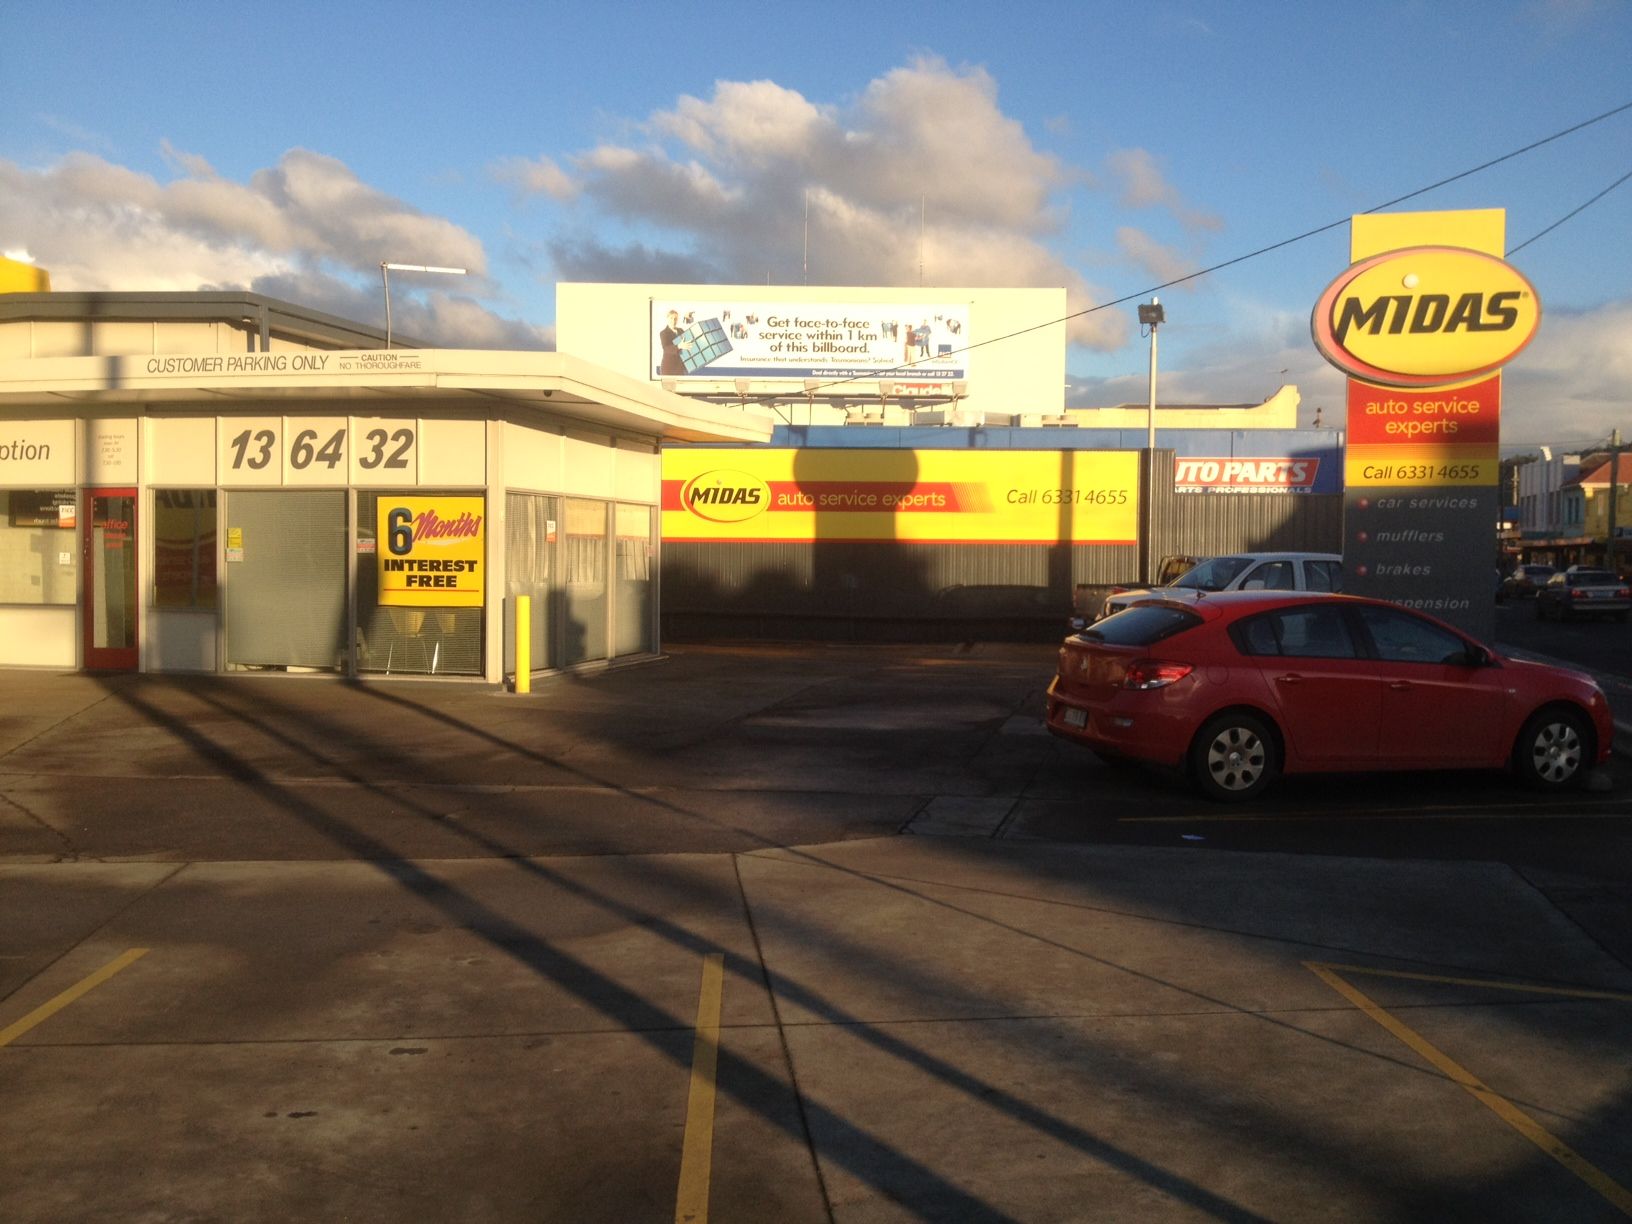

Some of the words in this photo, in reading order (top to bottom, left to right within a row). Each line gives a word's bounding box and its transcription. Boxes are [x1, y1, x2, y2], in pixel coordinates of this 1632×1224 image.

[767, 316, 790, 328] Get
[794, 317, 870, 329] face-to-face
[1336, 291, 1521, 345] MIDAS
[759, 330, 802, 340] service
[806, 330, 843, 341] within
[848, 330, 853, 341] 1
[858, 330, 878, 341] km
[770, 341, 783, 352] of
[786, 341, 808, 353] this
[812, 341, 870, 353] billboard.
[147, 358, 223, 373] CUSTOMER
[227, 355, 287, 372] PARKING
[291, 354, 329, 370] ONLY
[361, 353, 398, 362] CAUTION
[356, 361, 422, 370] THOROUGHFARE
[1365, 399, 1408, 414] auto
[1413, 396, 1480, 414] service
[1385, 418, 1458, 438] experts
[231, 430, 276, 469] 13
[290, 429, 346, 469] 64
[359, 428, 414, 469] 32
[1222, 461, 1309, 483] PARTS
[1363, 465, 1392, 479] Call
[690, 486, 761, 506] MIDAS
[1006, 489, 1037, 504] Call
[1207, 486, 1312, 494] PROFESSIONALS
[777, 491, 814, 506] auto
[819, 489, 877, 506] service
[882, 491, 946, 510] experts
[1377, 498, 1404, 509] car
[1409, 497, 1478, 509] services
[388, 507, 412, 555] 6
[410, 509, 482, 543] Months
[1376, 529, 1445, 542] mufflers
[384, 559, 477, 572] INTEREST
[1376, 563, 1432, 576] brakes
[406, 575, 457, 588] FREE
[1385, 596, 1470, 609] spension
